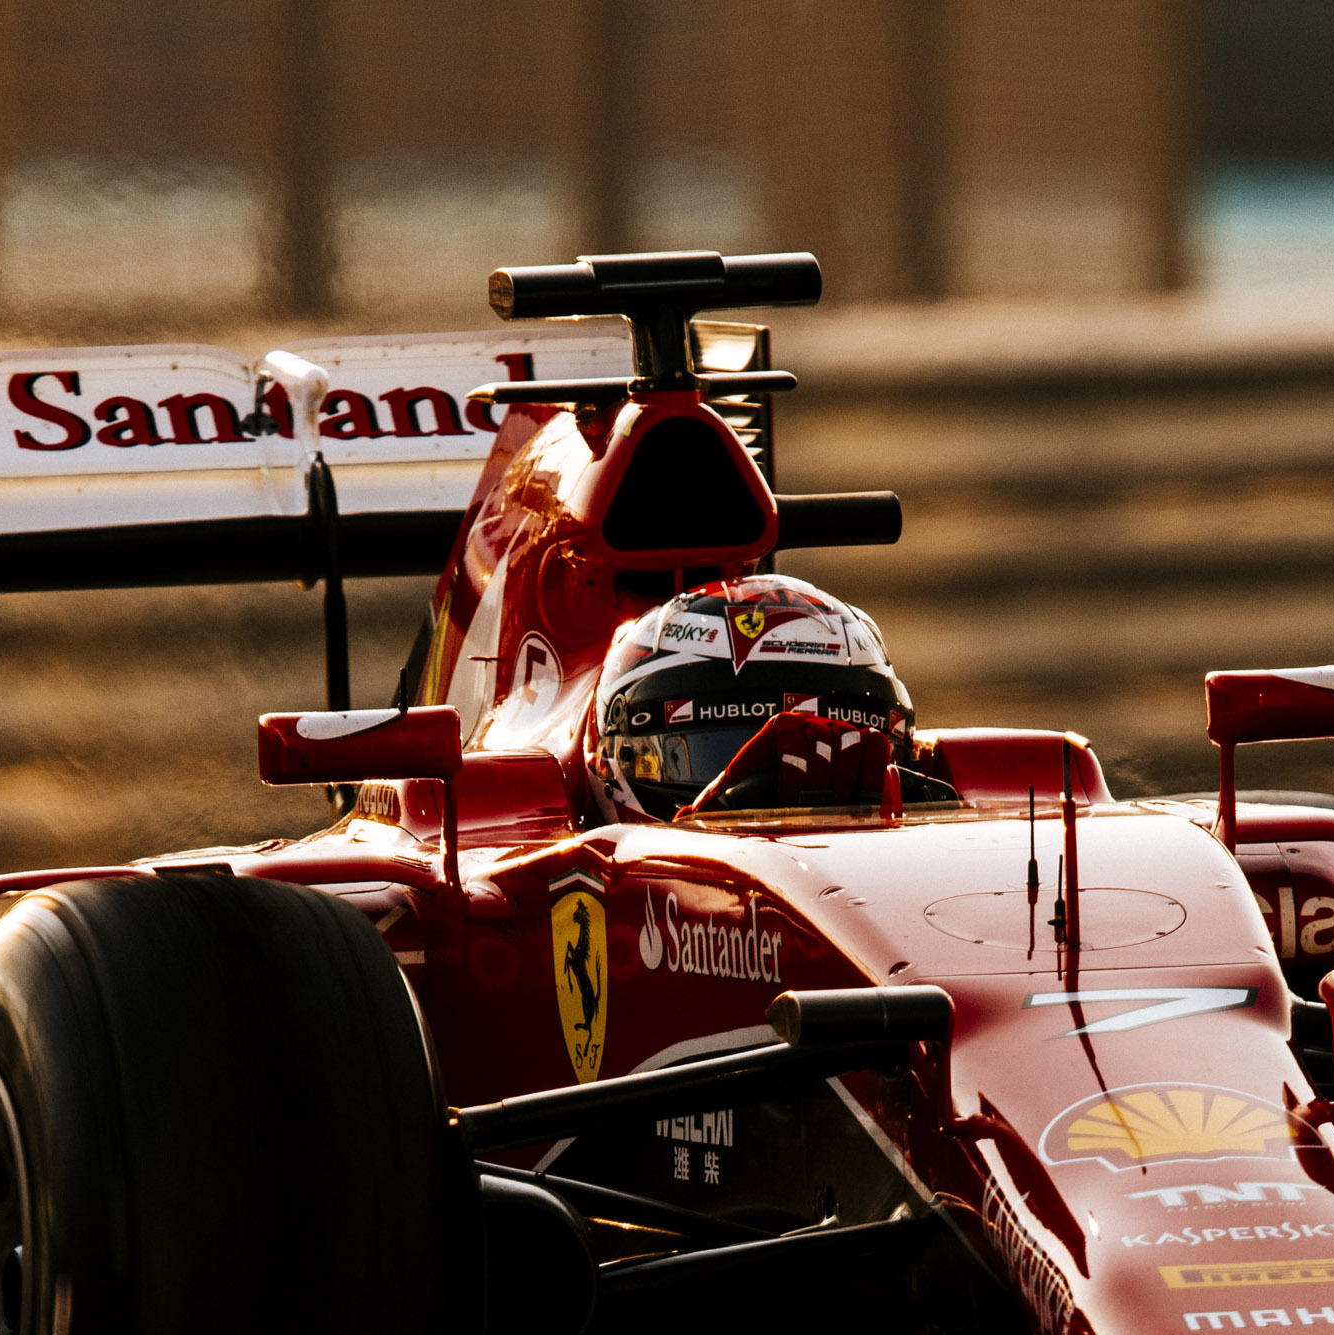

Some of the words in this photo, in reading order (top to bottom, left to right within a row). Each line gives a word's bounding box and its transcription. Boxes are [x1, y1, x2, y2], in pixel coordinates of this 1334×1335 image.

[8, 352, 535, 451] Santand
[762, 640, 826, 649] SCUDERIA
[787, 647, 840, 656] FERRARI
[700, 702, 777, 720] HUBLOT
[828, 706, 886, 729] HUBLOT
[666, 891, 782, 983] Santander
[1123, 1181, 1326, 1207] TNT
